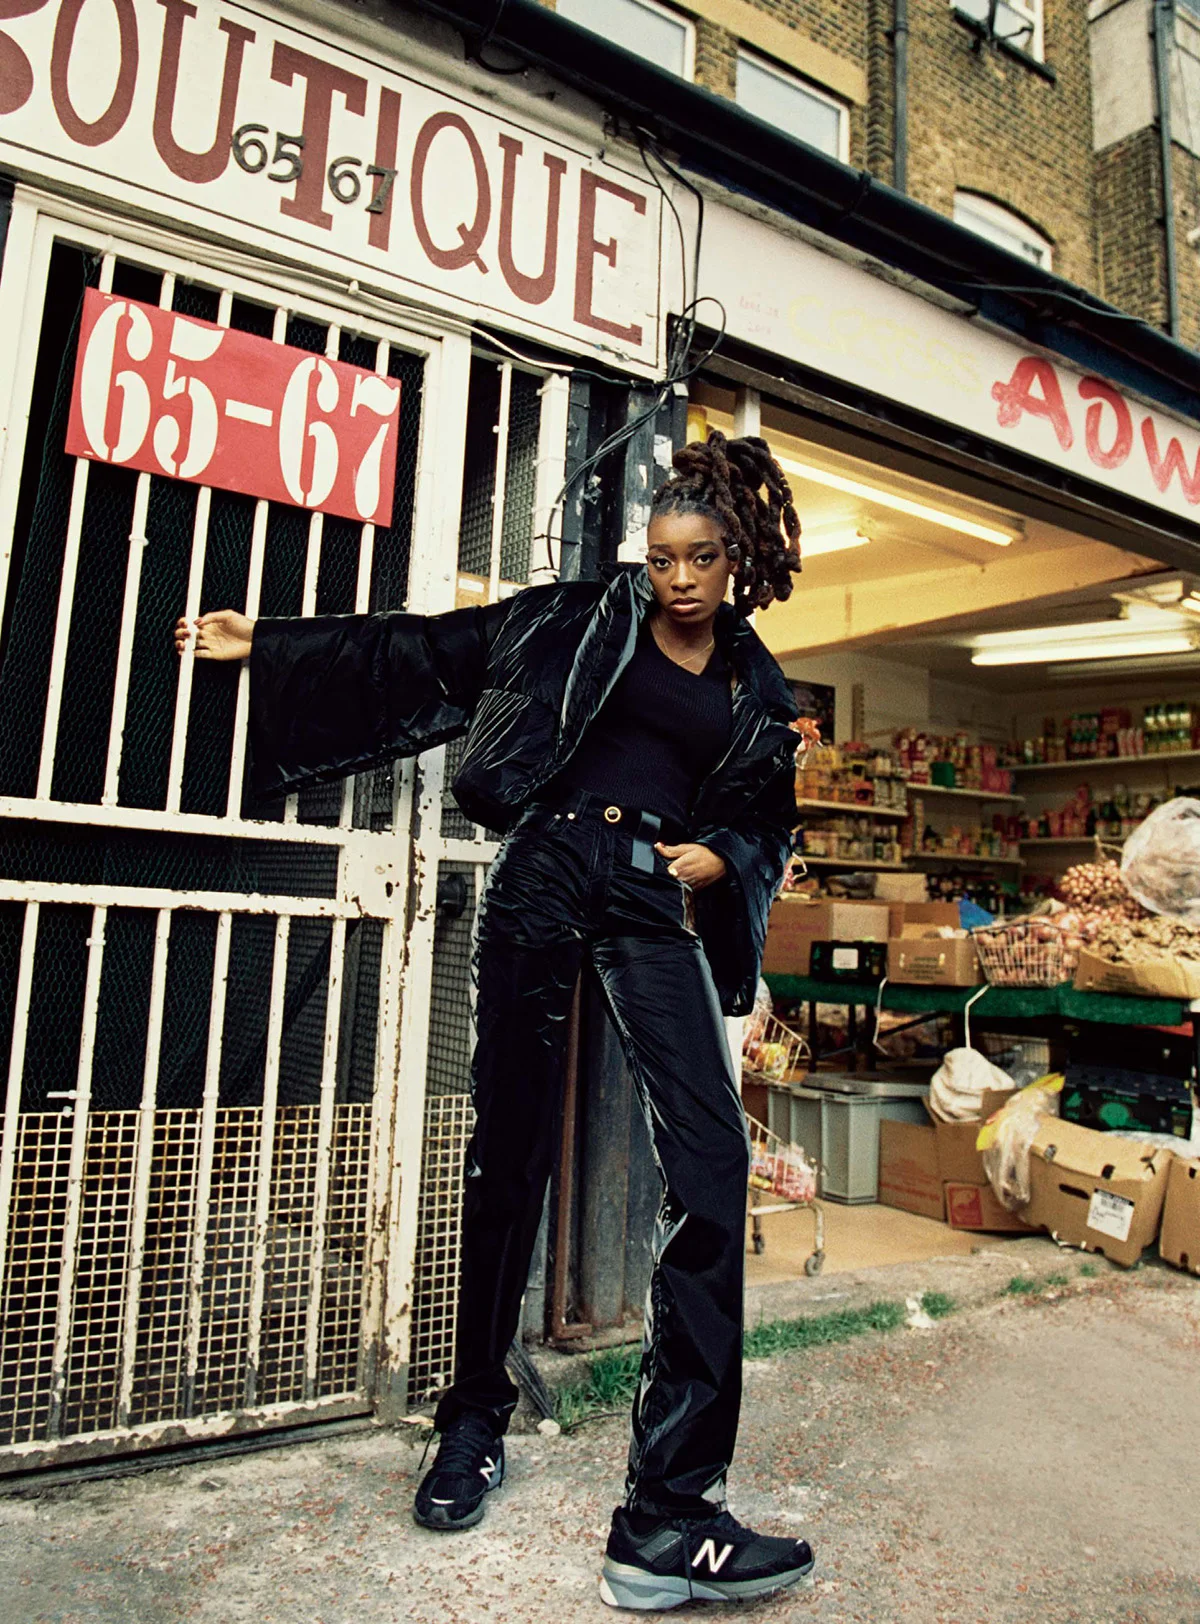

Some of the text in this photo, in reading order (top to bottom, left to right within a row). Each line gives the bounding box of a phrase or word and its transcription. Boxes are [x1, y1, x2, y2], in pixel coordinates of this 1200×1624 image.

[232, 123, 398, 215] 65 67
[81, 301, 400, 520] 65-67
[691, 1538, 735, 1574] N
